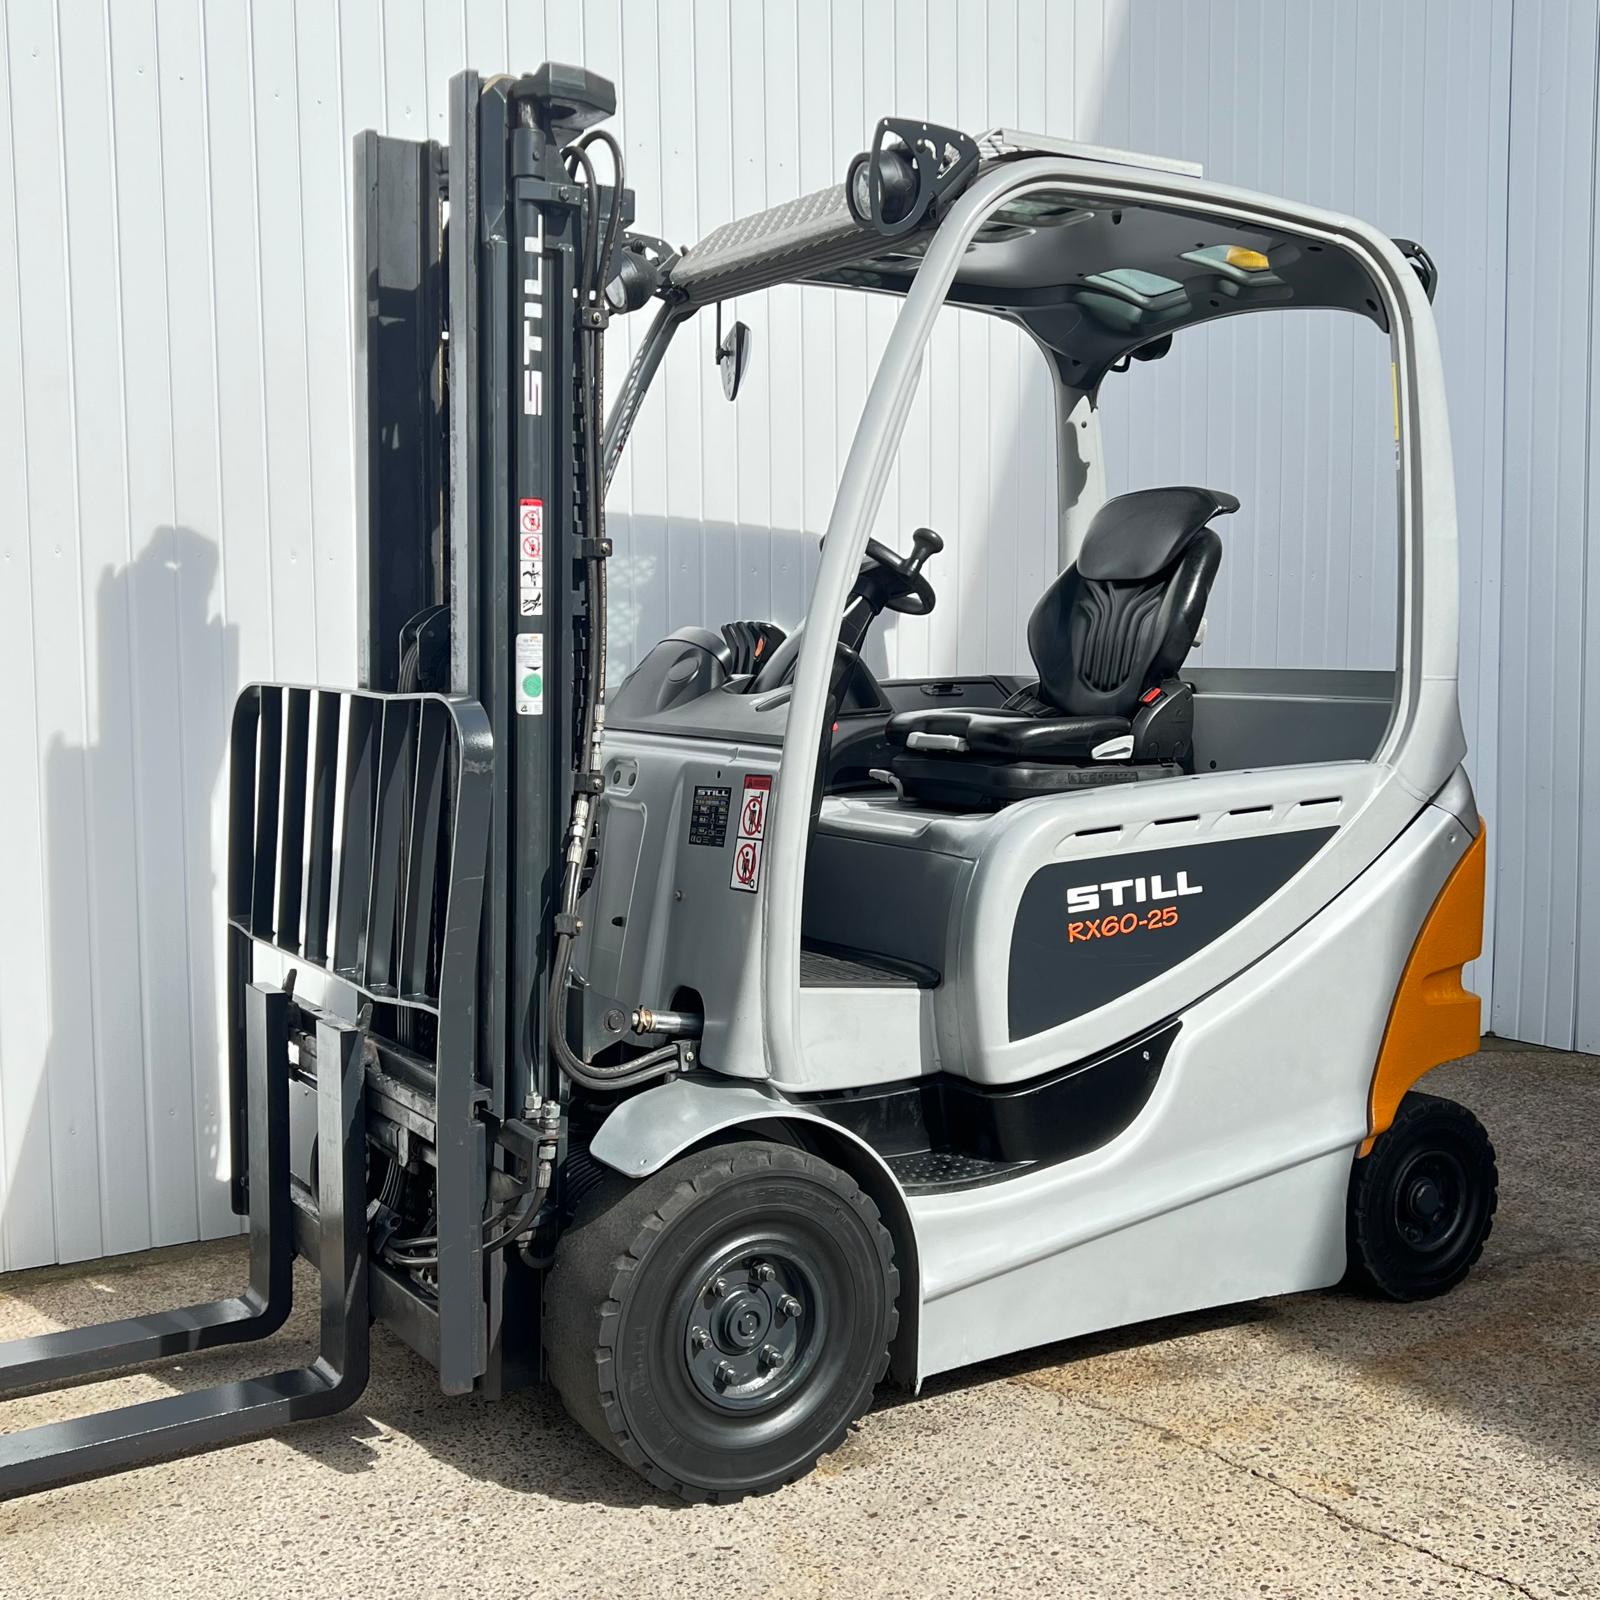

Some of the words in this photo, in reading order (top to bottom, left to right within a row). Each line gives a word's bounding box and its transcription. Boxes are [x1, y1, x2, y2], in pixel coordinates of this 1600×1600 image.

[524, 214, 543, 416] STILL
[1067, 871, 1203, 914] STILL
[1068, 906, 1179, 943] RX60-25
